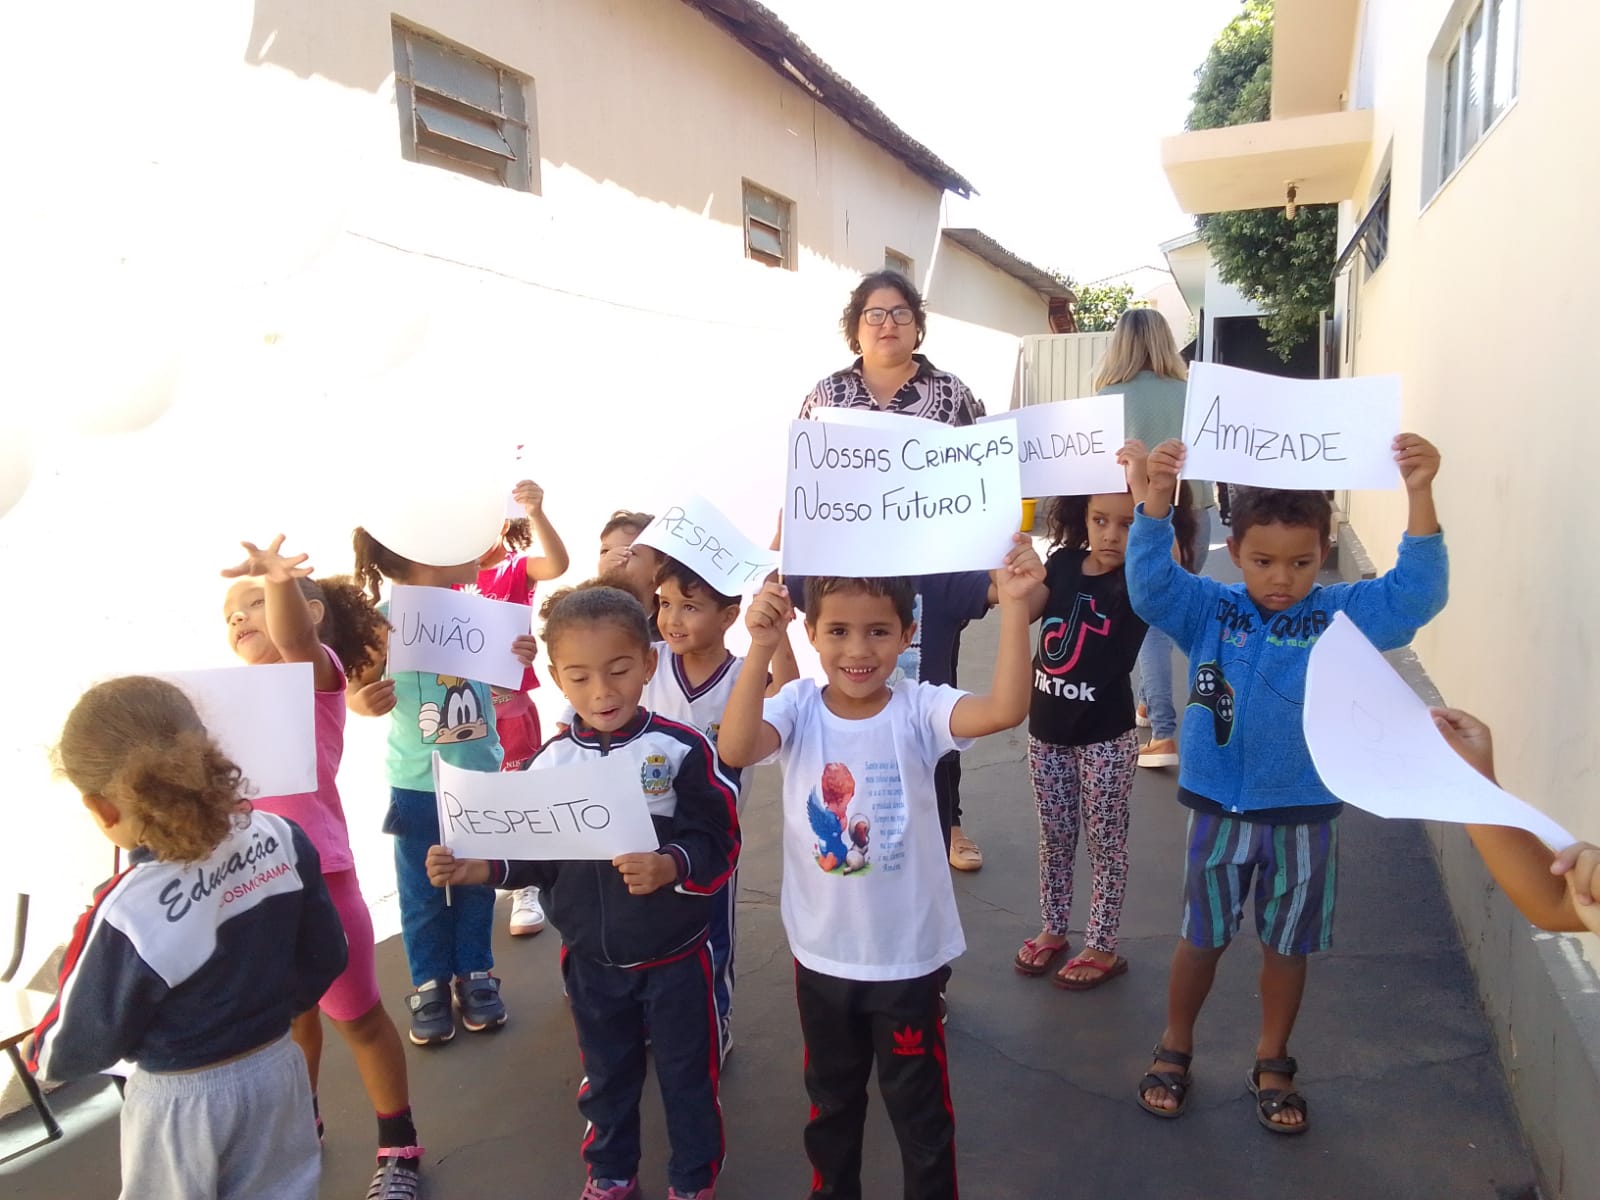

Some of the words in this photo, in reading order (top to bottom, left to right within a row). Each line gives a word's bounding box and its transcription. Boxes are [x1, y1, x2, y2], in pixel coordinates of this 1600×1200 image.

[795, 423, 891, 472] NOSSAS
[902, 436, 1013, 470] CRIANÇAS
[1019, 430, 1105, 463] UALDADE
[794, 481, 871, 521] NOSSO
[655, 506, 770, 582] RESPEIT
[402, 611, 485, 653] UNIÃO
[1034, 668, 1096, 701] TikTok
[444, 792, 610, 834] RESPEITO
[159, 833, 279, 922] Educação
